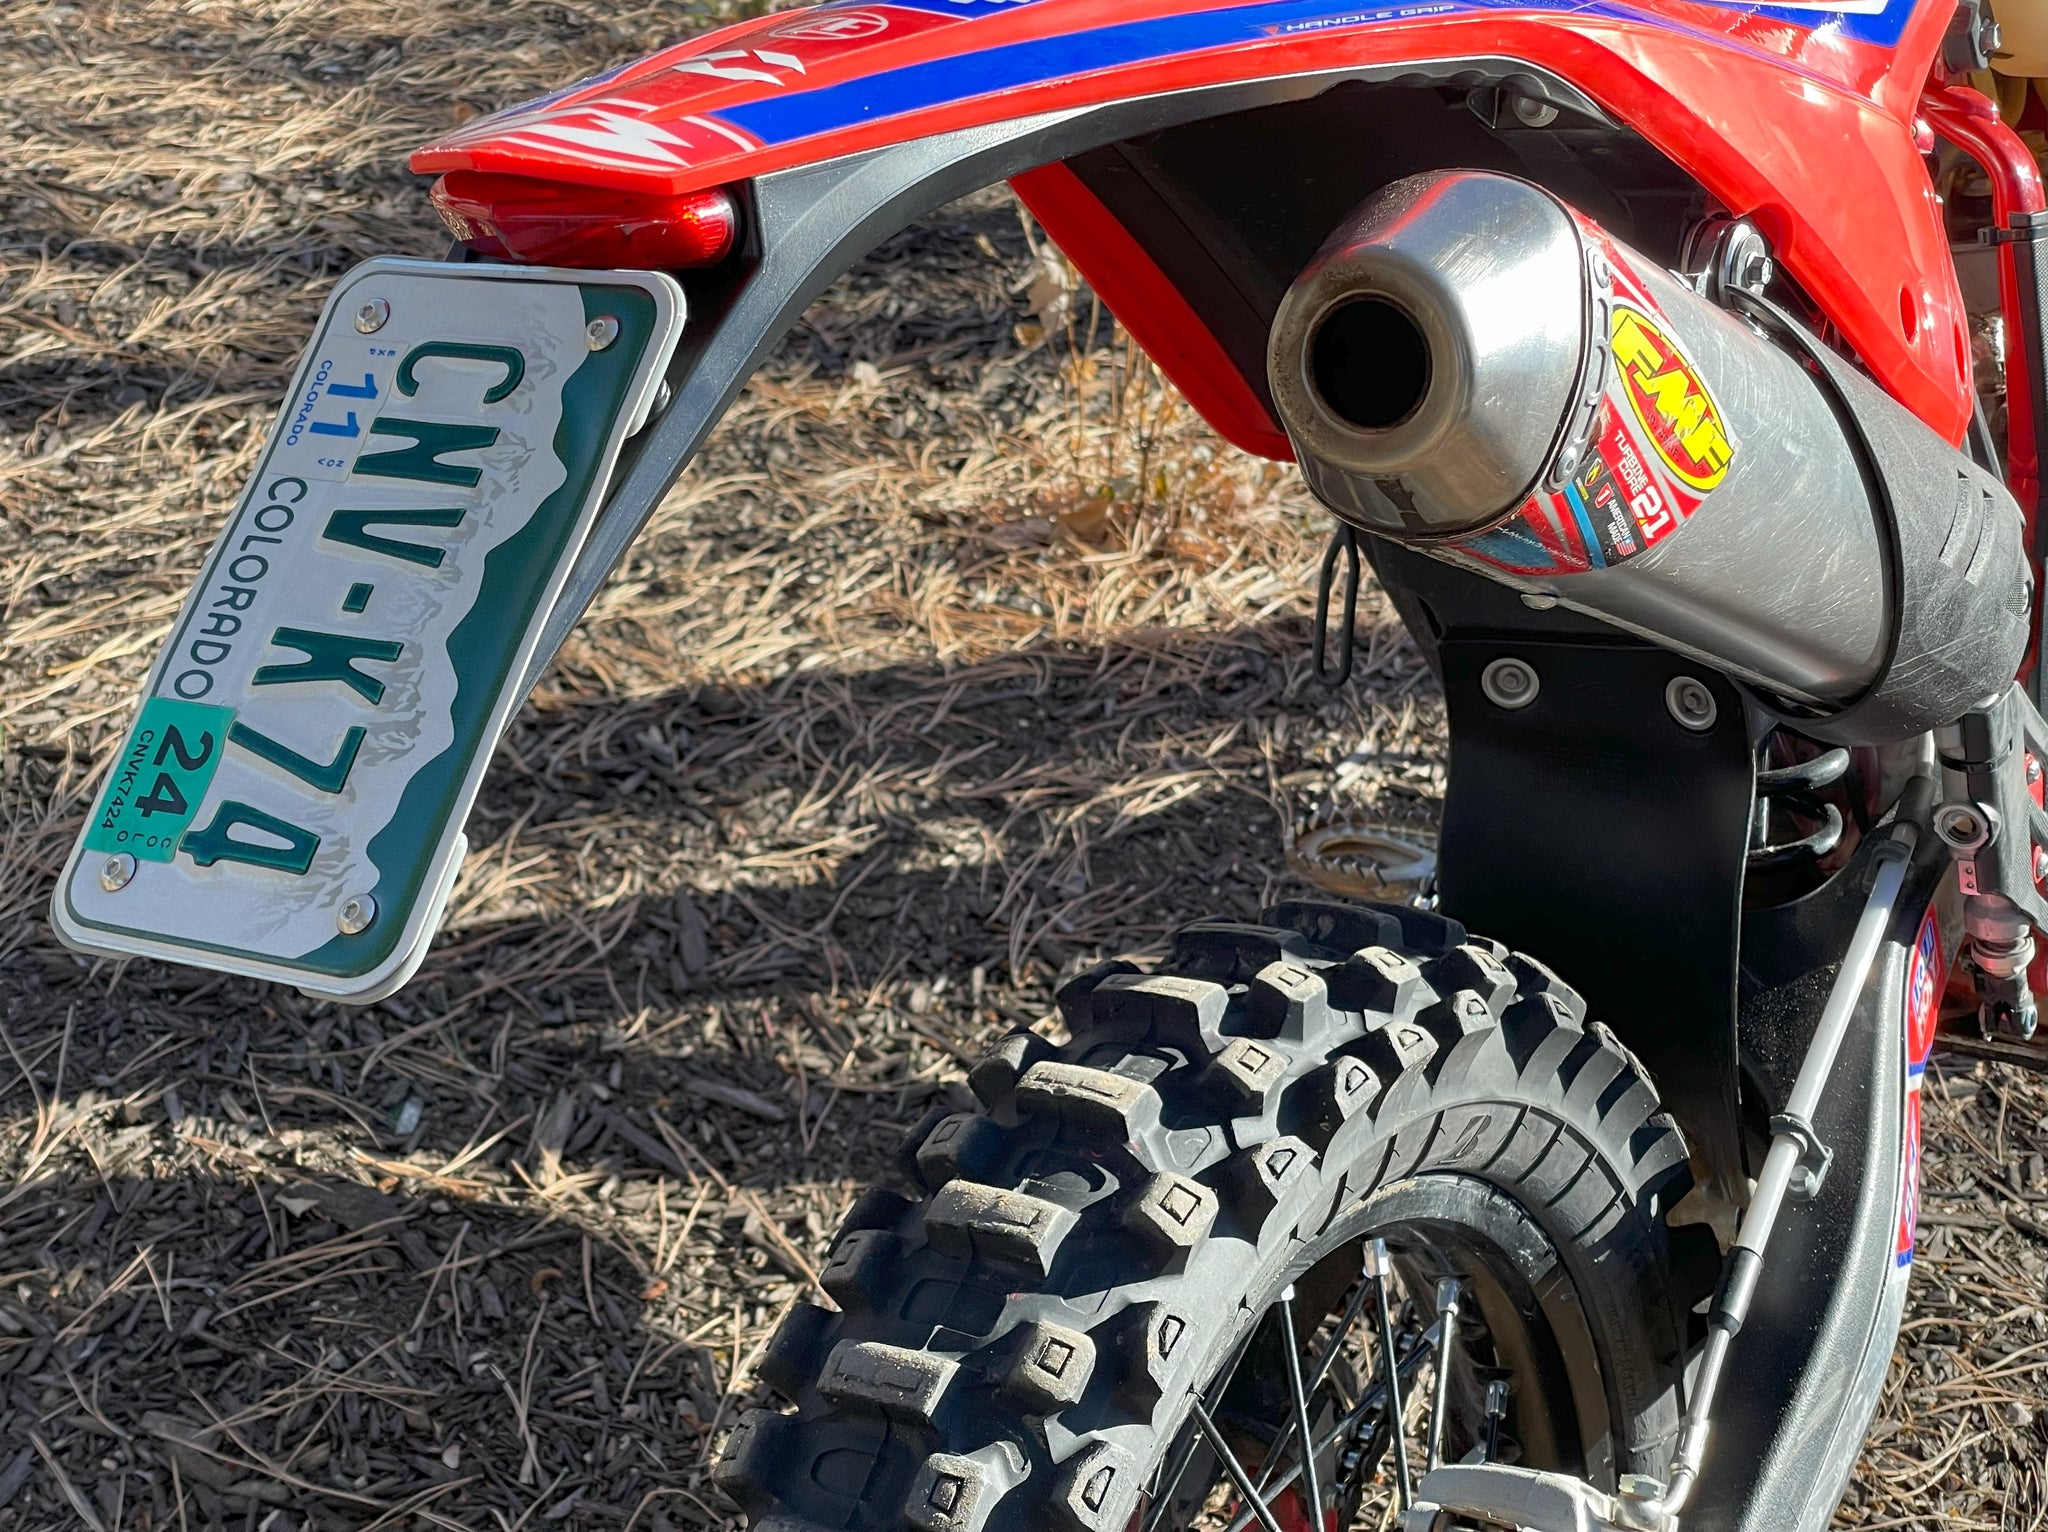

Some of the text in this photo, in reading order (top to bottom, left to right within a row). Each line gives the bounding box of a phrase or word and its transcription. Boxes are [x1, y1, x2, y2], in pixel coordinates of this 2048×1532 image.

[1286, 5, 1455, 32] HANDLE GRIP
[369, 348, 396, 357] EXP
[286, 360, 333, 446] COLORADO
[308, 373, 379, 437] 11
[1611, 314, 1735, 476] FMF
[317, 458, 345, 468] NOV
[1614, 429, 1649, 491] TURBINE
[1617, 460, 1641, 497] CORE
[1606, 498, 1632, 540] AMERICAN
[1606, 521, 1623, 545] MADE
[174, 477, 308, 700] COLORADO
[180, 341, 526, 876] CNV-K74
[101, 729, 155, 830] CNVK7424
[135, 724, 214, 818] 24
[116, 830, 172, 849] COLO
